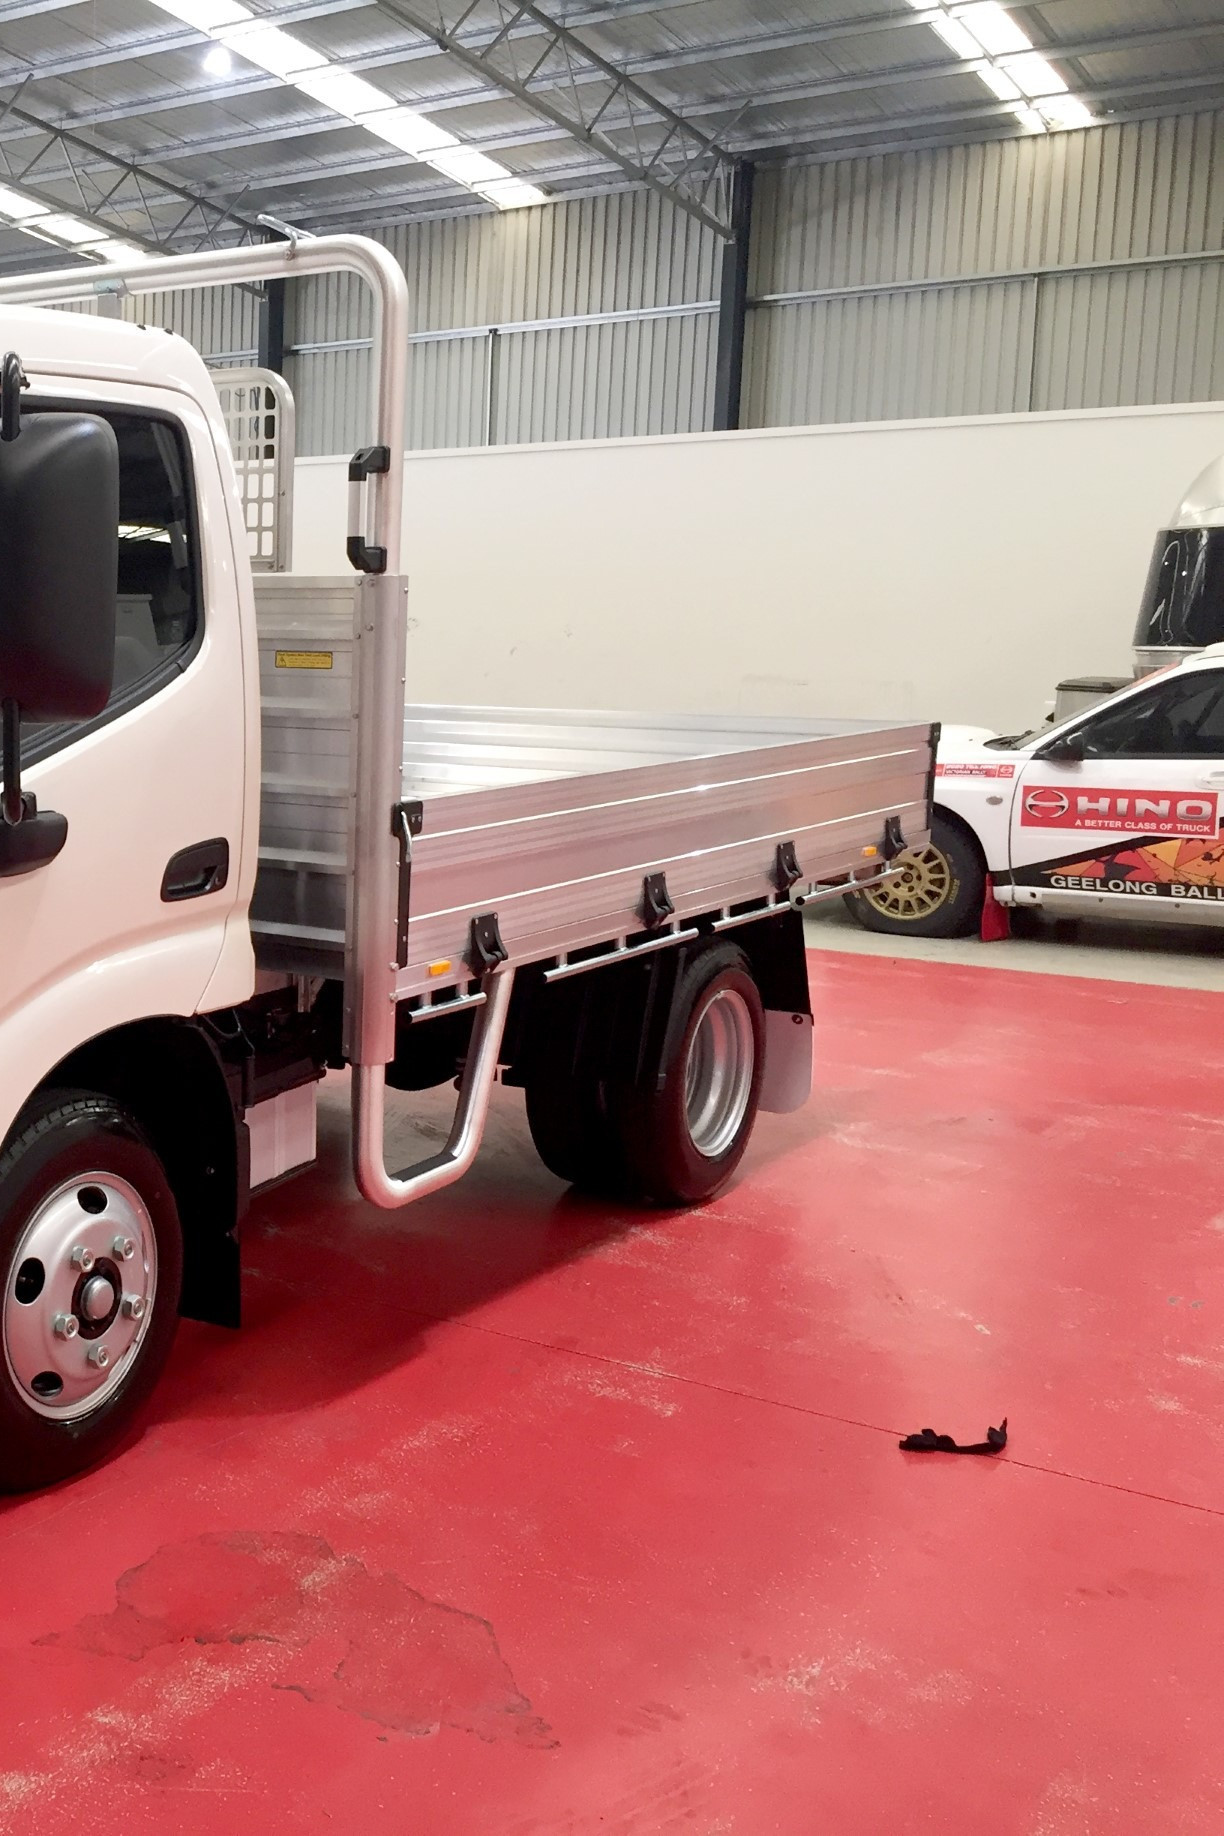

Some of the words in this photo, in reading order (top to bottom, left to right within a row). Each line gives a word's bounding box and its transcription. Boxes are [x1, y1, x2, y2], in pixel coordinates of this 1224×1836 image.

[1076, 796, 1213, 821] HINO
[1074, 819, 1082, 827] A
[1084, 819, 1122, 828] BETTER
[1124, 821, 1157, 830] CLASS
[1159, 823, 1173, 831] OF
[1176, 823, 1211, 832] TRUCK
[1050, 875, 1158, 895] GEELONG
